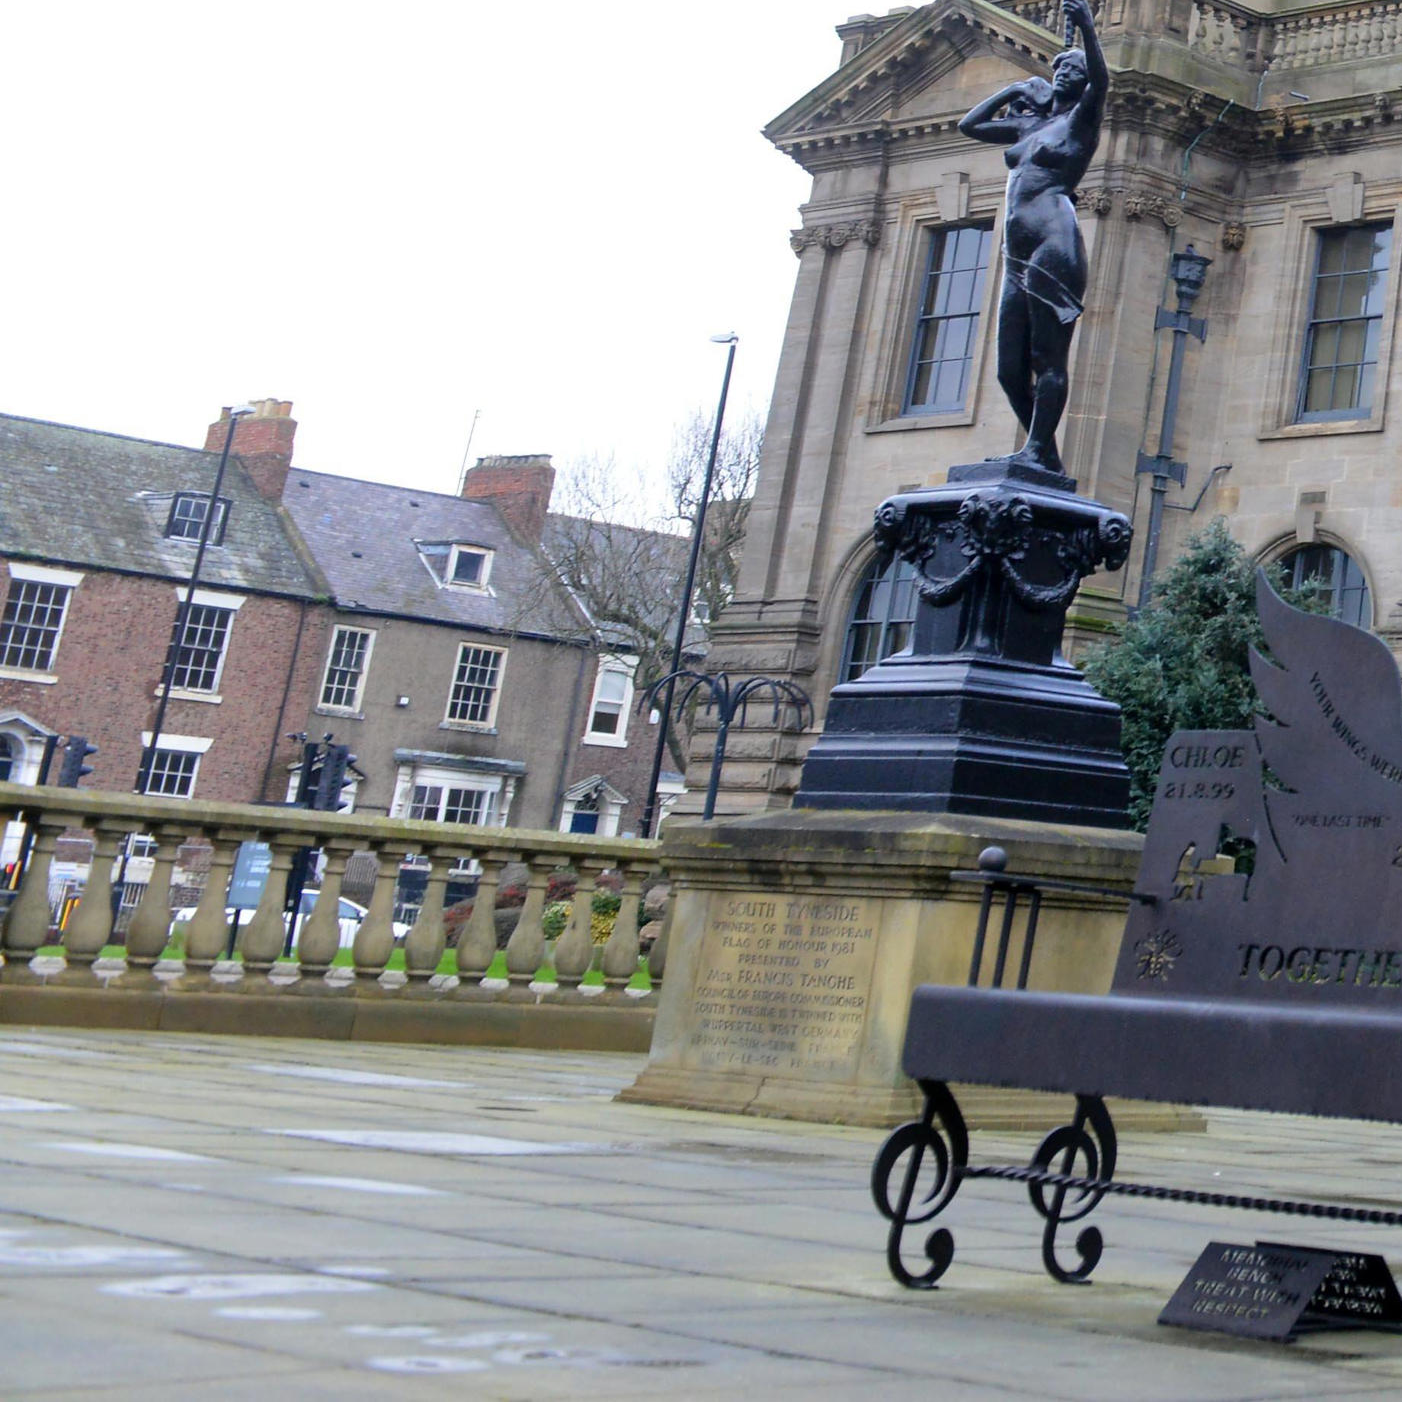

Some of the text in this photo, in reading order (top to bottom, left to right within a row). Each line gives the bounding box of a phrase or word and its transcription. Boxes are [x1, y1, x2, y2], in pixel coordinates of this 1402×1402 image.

[1309, 670, 1336, 719] YOUR
[1331, 715, 1367, 763] WINGS
[1170, 745, 1246, 769] CHLOE
[1164, 781, 1235, 800] 21.8.99
[727, 901, 860, 922] SOUTH TYNESIDE
[763, 922, 777, 935] OF
[722, 936, 855, 955] FLAG OF HONOUR 1981
[738, 953, 831, 970] PRESENTED BY
[737, 969, 794, 988] FRANCIS
